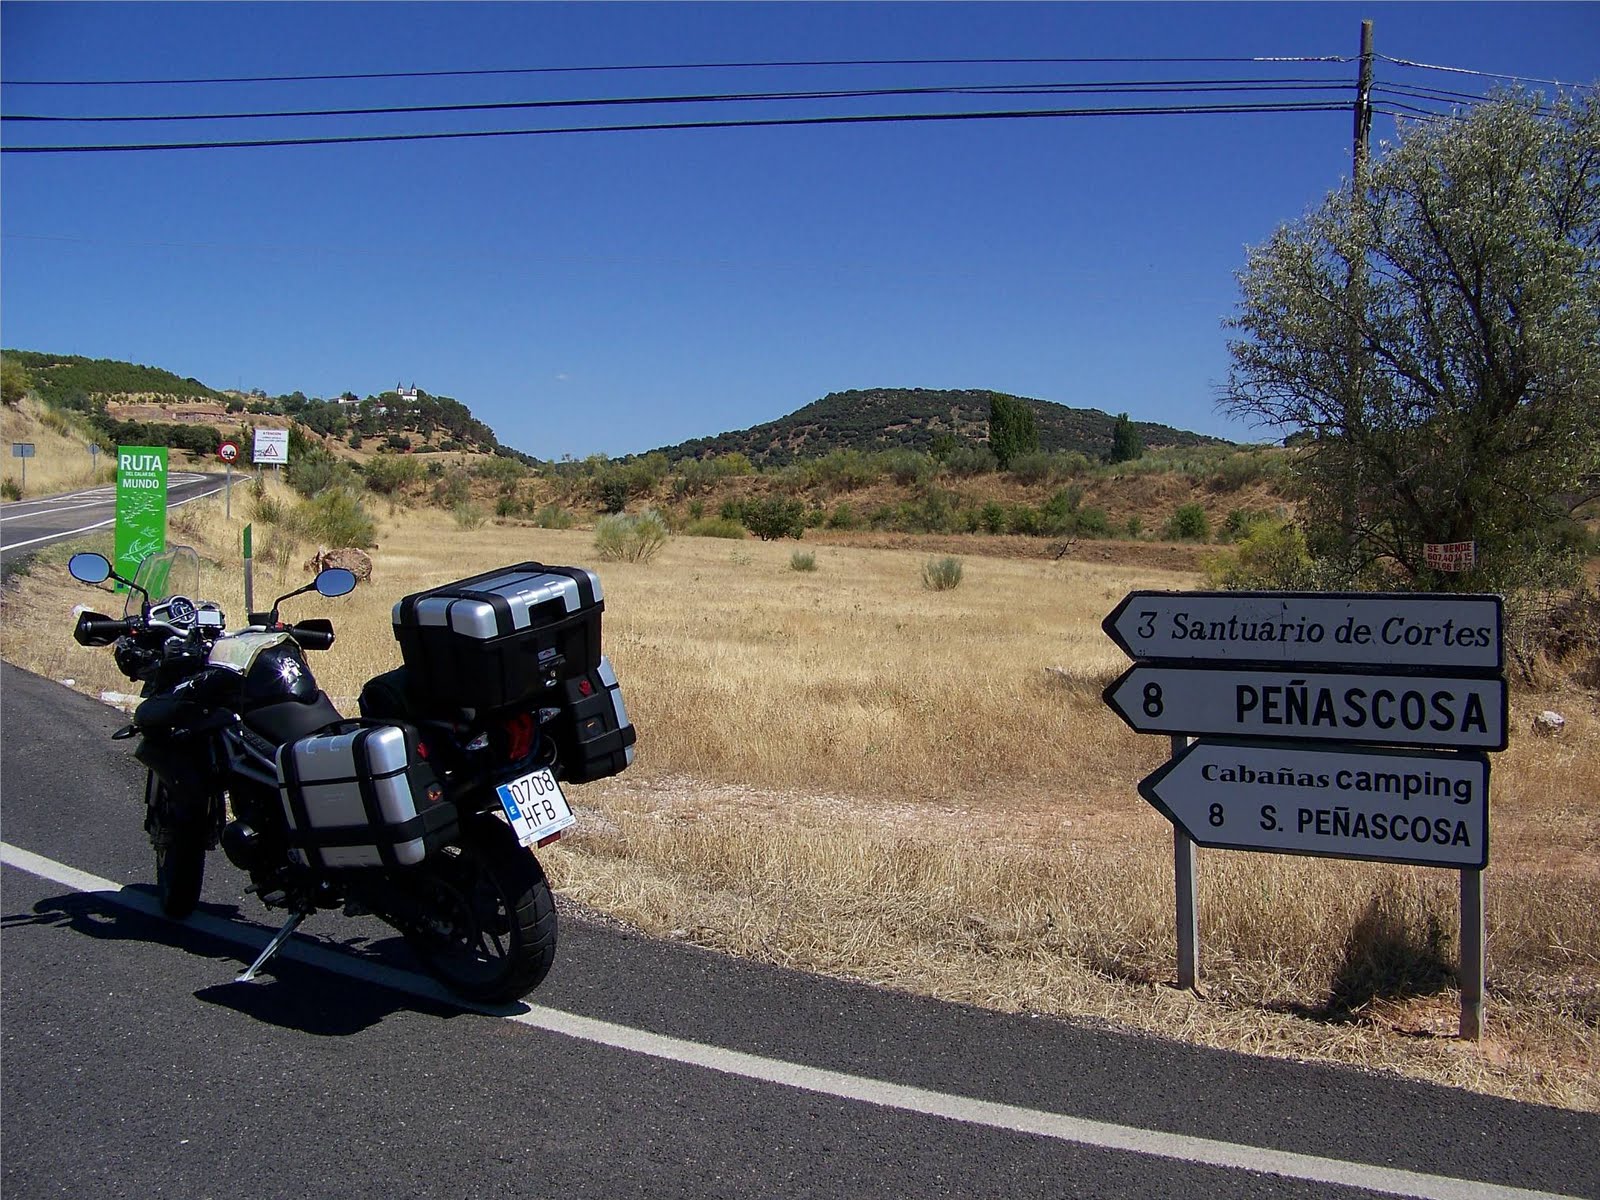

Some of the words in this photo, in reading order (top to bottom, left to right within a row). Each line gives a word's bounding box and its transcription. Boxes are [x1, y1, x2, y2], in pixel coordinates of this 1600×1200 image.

[120, 454, 163, 471] RUTA
[122, 478, 160, 489] MUNDO
[1427, 545, 1439, 553] SE
[1443, 543, 1472, 553] VENDE
[1137, 611, 1158, 639] 3
[1171, 612, 1325, 644] Santuario
[1334, 617, 1371, 645] de
[1381, 616, 1491, 648] Cortes
[1142, 682, 1164, 718] 8
[1236, 679, 1488, 734] PEÑASCOSA
[511, 771, 555, 805] 0708
[1201, 763, 1330, 788] Cabañas
[1336, 769, 1473, 805] camping
[509, 806, 516, 814] E
[521, 799, 556, 830] HFB
[1208, 802, 1225, 827] 8
[1259, 804, 1284, 832] S.
[1297, 806, 1471, 848] PEÑASCOSA
